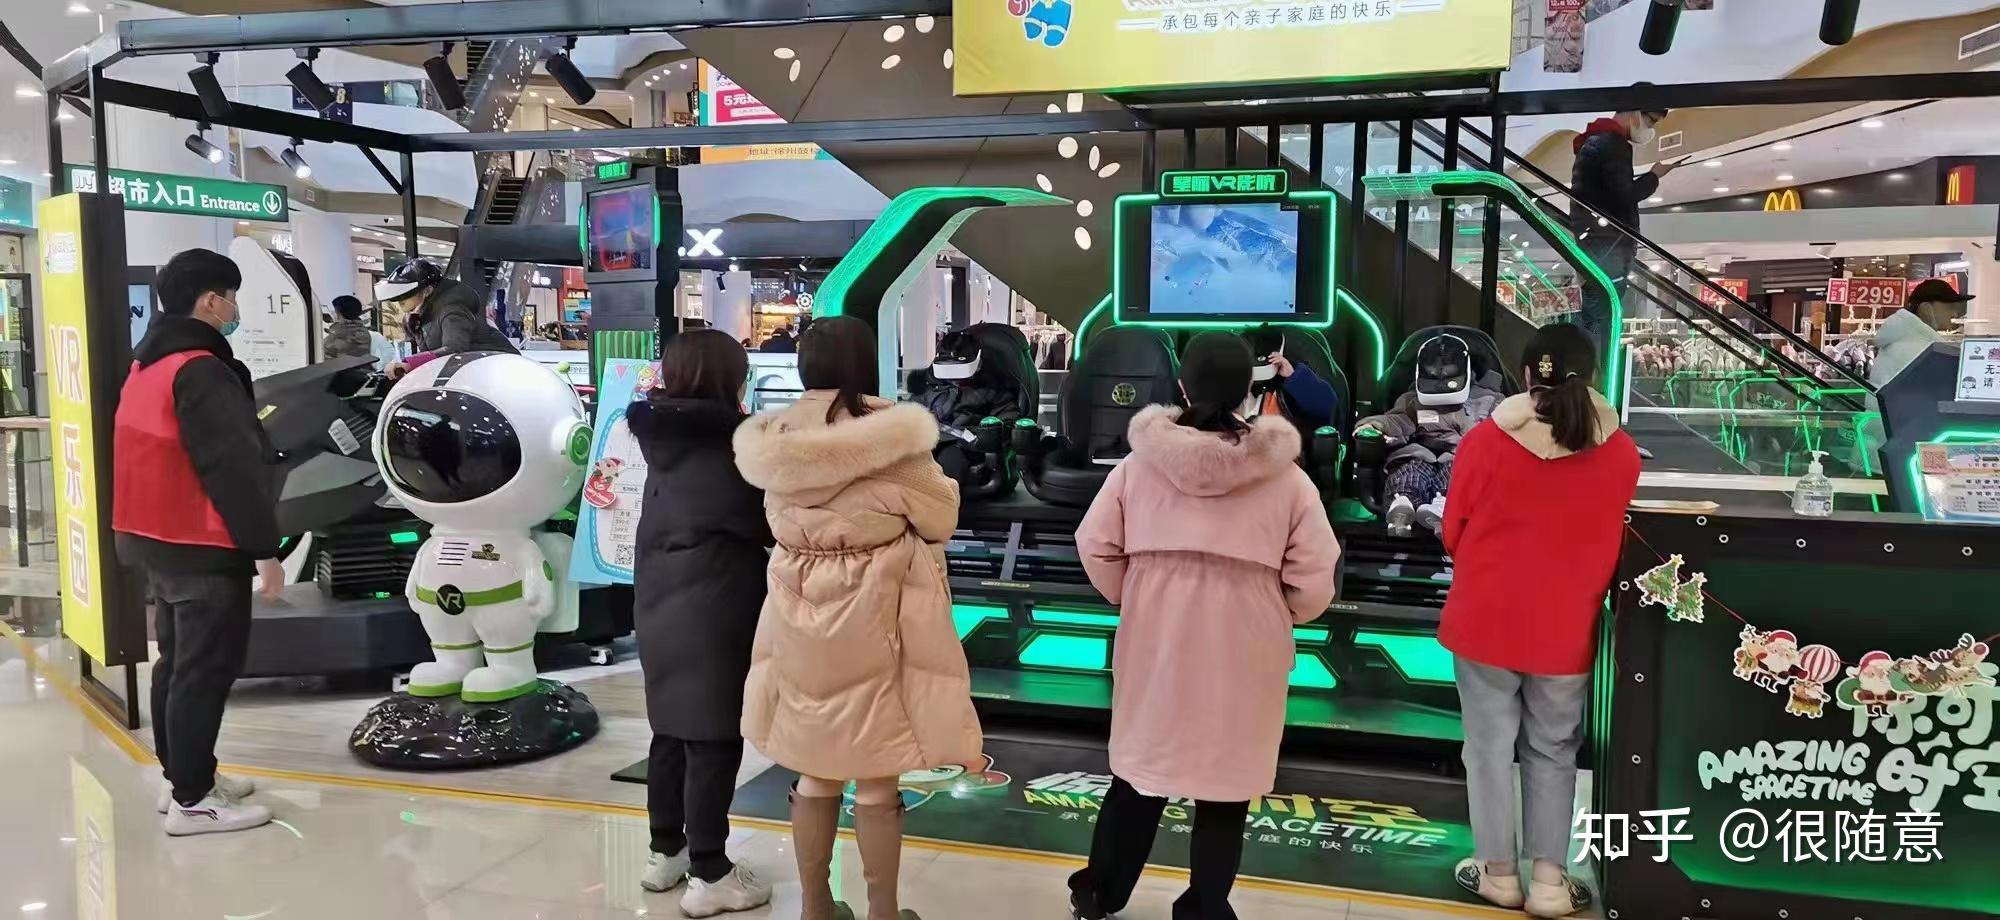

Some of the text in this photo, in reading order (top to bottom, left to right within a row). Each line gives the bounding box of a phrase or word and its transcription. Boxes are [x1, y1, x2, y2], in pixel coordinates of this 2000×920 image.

[1161, 0, 1393, 31] 承包每个亲子家庭的快乐
[200, 194, 260, 213] Entrance
[266, 294, 291, 314] 1F
[1857, 286, 1895, 304] 299
[1698, 739, 1871, 790] AMAZING
[1739, 773, 1877, 806] SPACETIME
